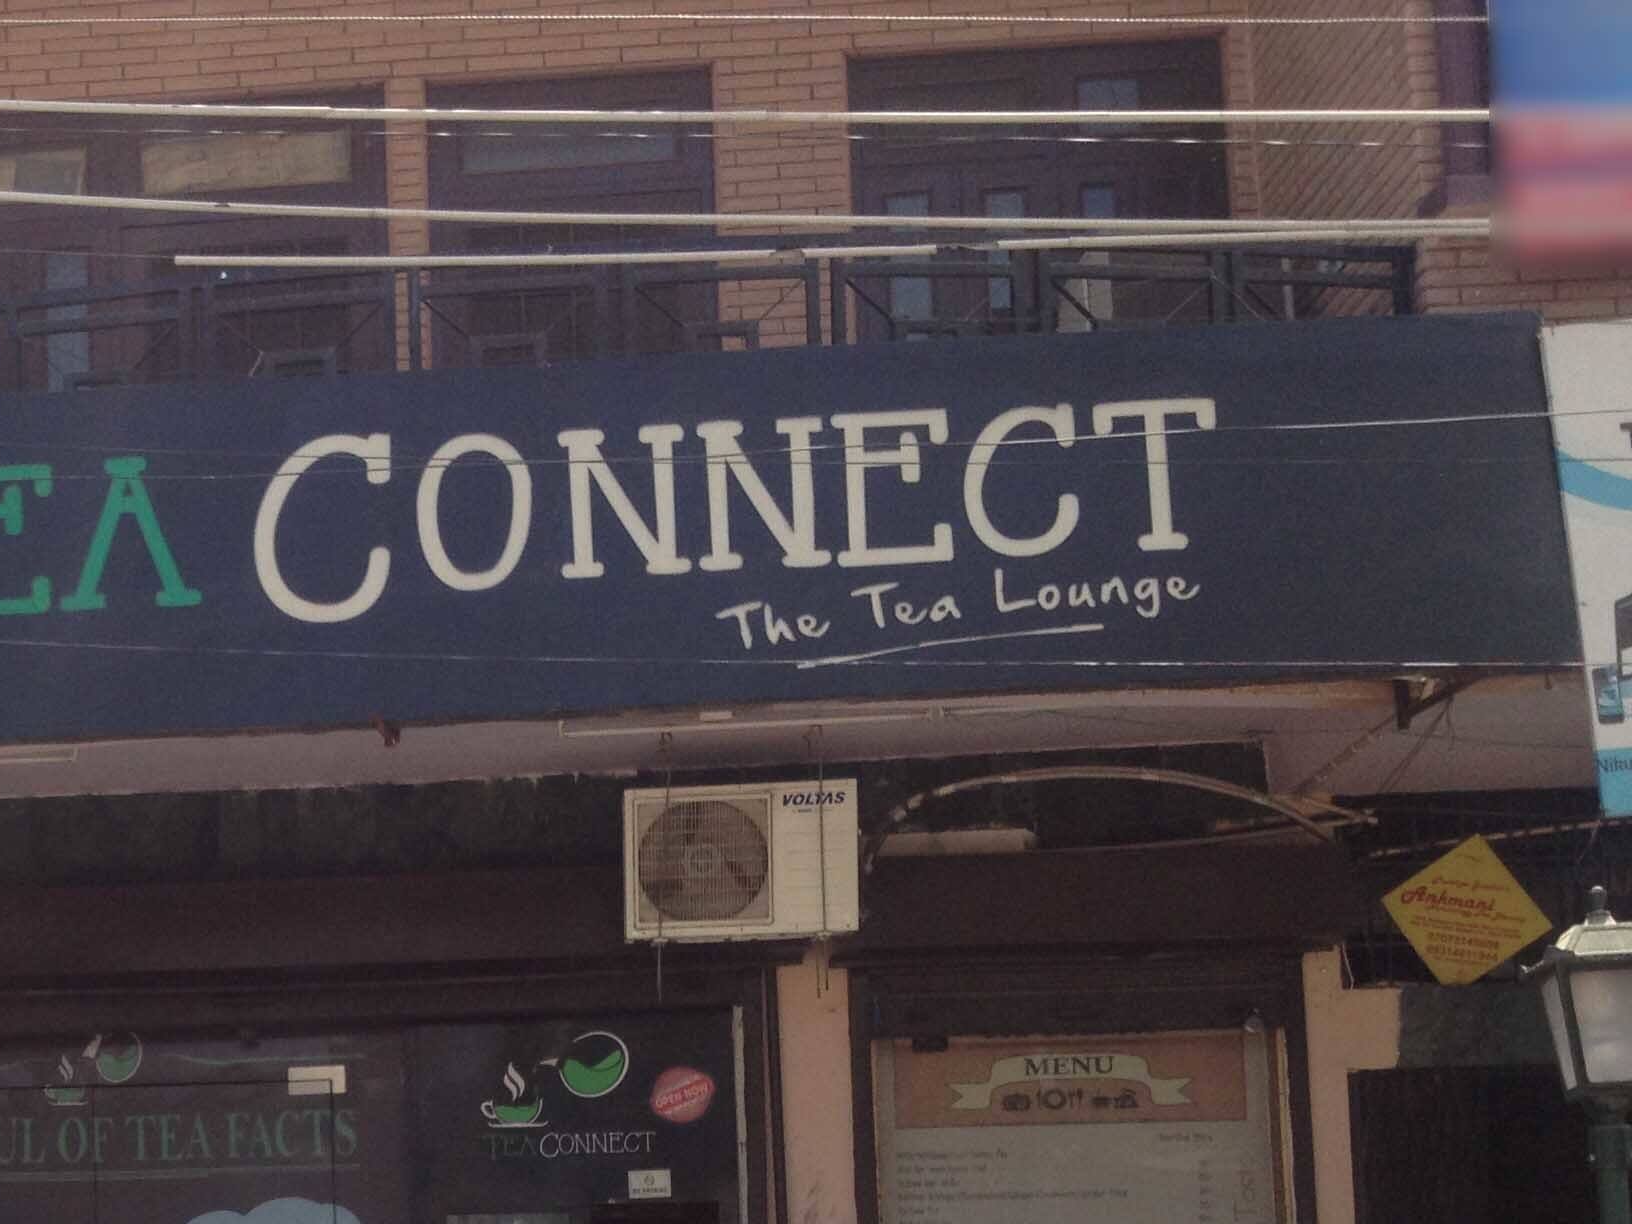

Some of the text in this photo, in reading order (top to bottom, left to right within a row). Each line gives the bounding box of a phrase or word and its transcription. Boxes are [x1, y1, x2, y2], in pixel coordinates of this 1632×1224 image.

[253, 398, 1217, 624] CONNECT
[717, 566, 1201, 652] The Tea Lounge
[783, 791, 846, 806] VOLTAS
[1023, 1055, 1116, 1076] MENU
[56, 1114, 113, 1164] OF
[126, 1111, 217, 1161] TEA
[224, 1106, 360, 1160] FACTS
[484, 1130, 657, 1160] TEA CONNECT
